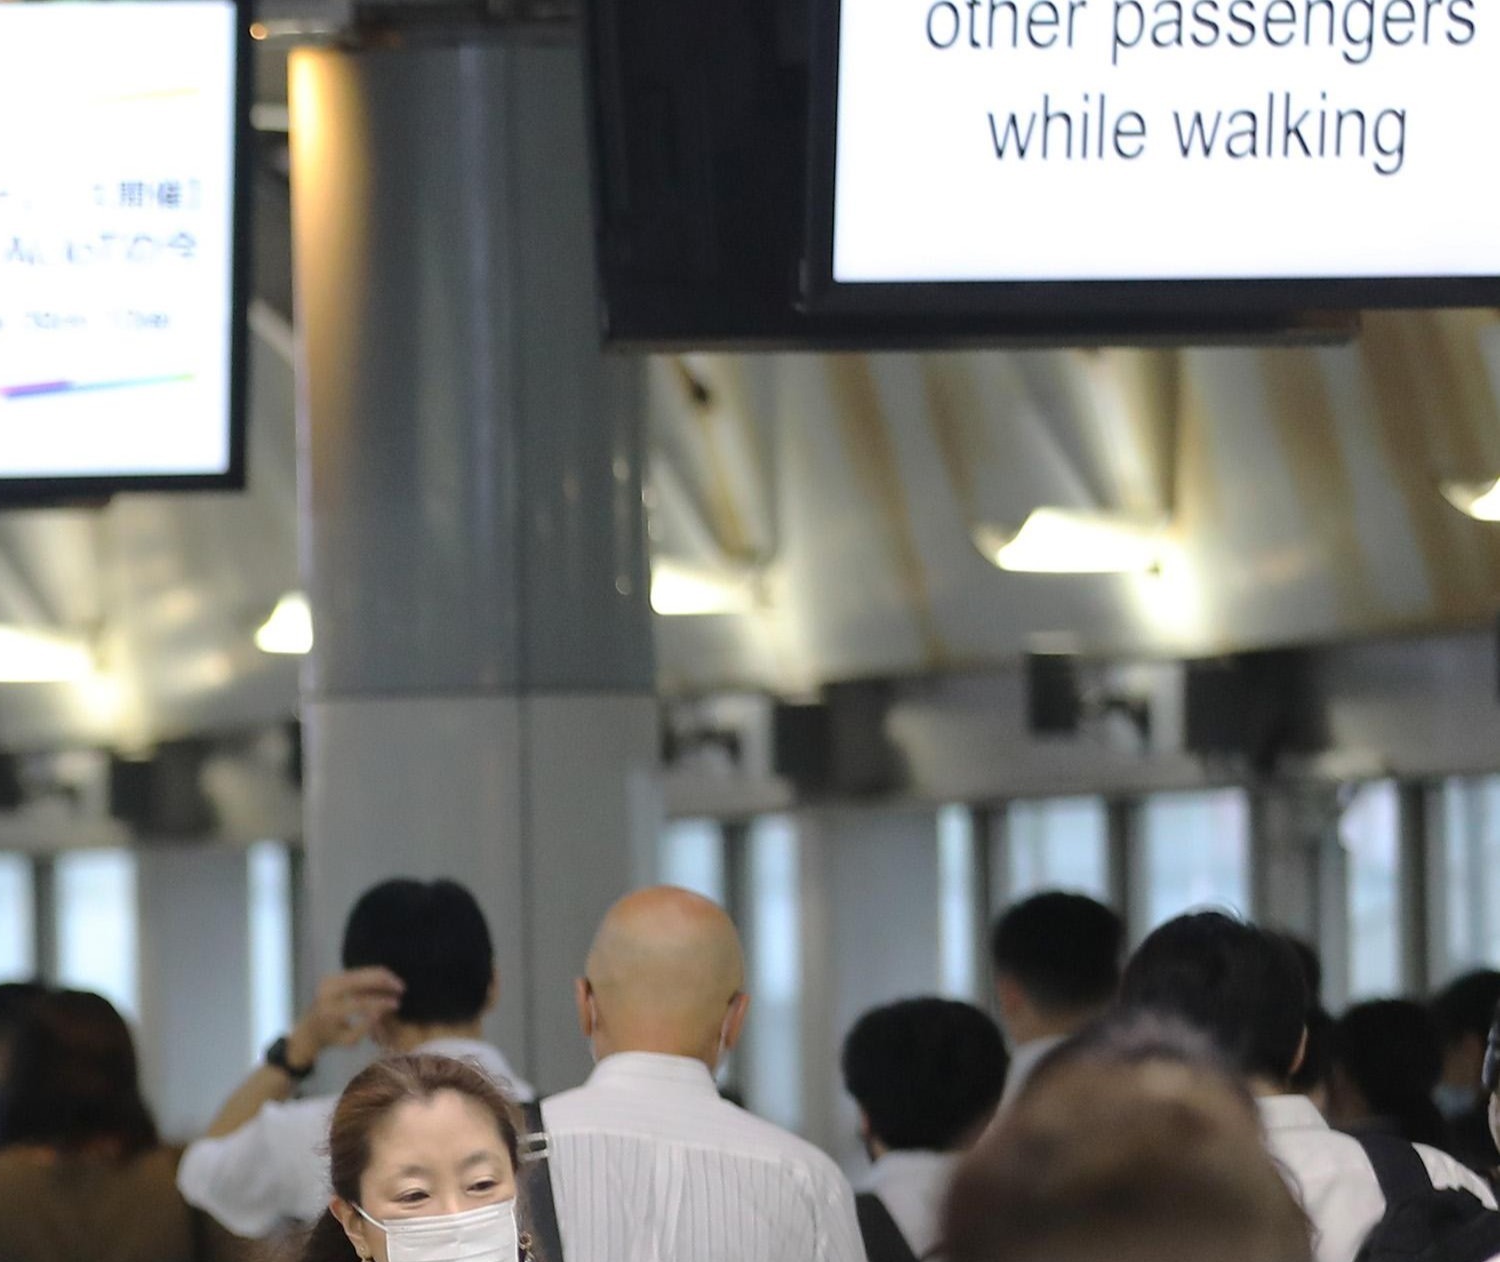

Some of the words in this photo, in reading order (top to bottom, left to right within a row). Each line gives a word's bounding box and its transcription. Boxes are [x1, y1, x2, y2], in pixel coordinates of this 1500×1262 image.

[926, 0, 1087, 49] other
[1112, 0, 1476, 65] passengers
[988, 93, 1146, 160] while
[1173, 91, 1406, 176] walking
